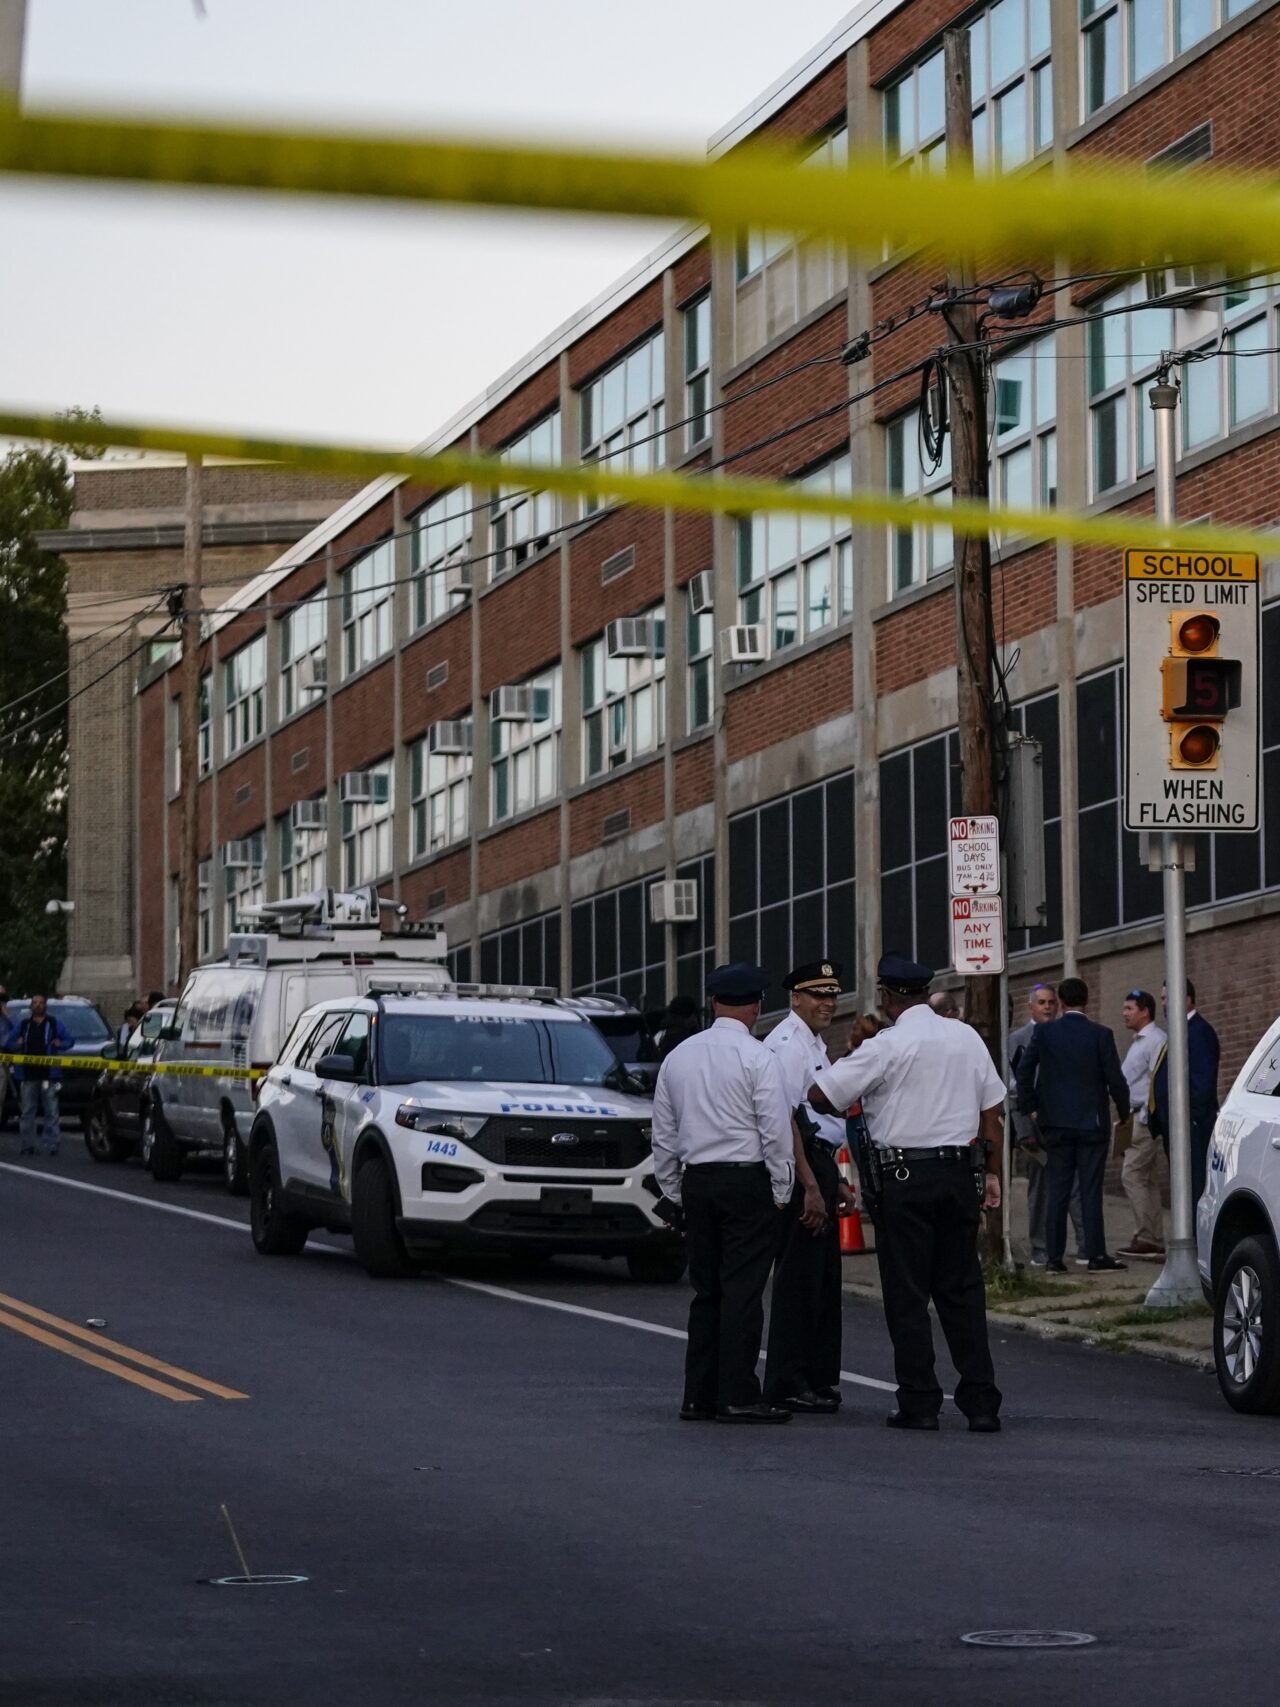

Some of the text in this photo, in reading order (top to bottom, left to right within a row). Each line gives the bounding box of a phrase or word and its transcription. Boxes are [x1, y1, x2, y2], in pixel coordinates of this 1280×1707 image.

[1142, 555, 1243, 577] SCHOOL
[1136, 583, 1249, 605] SPEED LIMIT
[1163, 779, 1224, 800] WHEN
[1140, 803, 1245, 824] FLASHING
[952, 821, 995, 839] NO PARKING
[958, 842, 992, 853] SCHOOL
[964, 853, 986, 863] DAYS
[954, 900, 998, 916] NO PARKING
[964, 922, 991, 934] ANY
[963, 938, 993, 949] TIME
[454, 1015, 528, 1025] POLICE
[500, 1103, 618, 1116] POLICE
[427, 1140, 458, 1157] 1443
